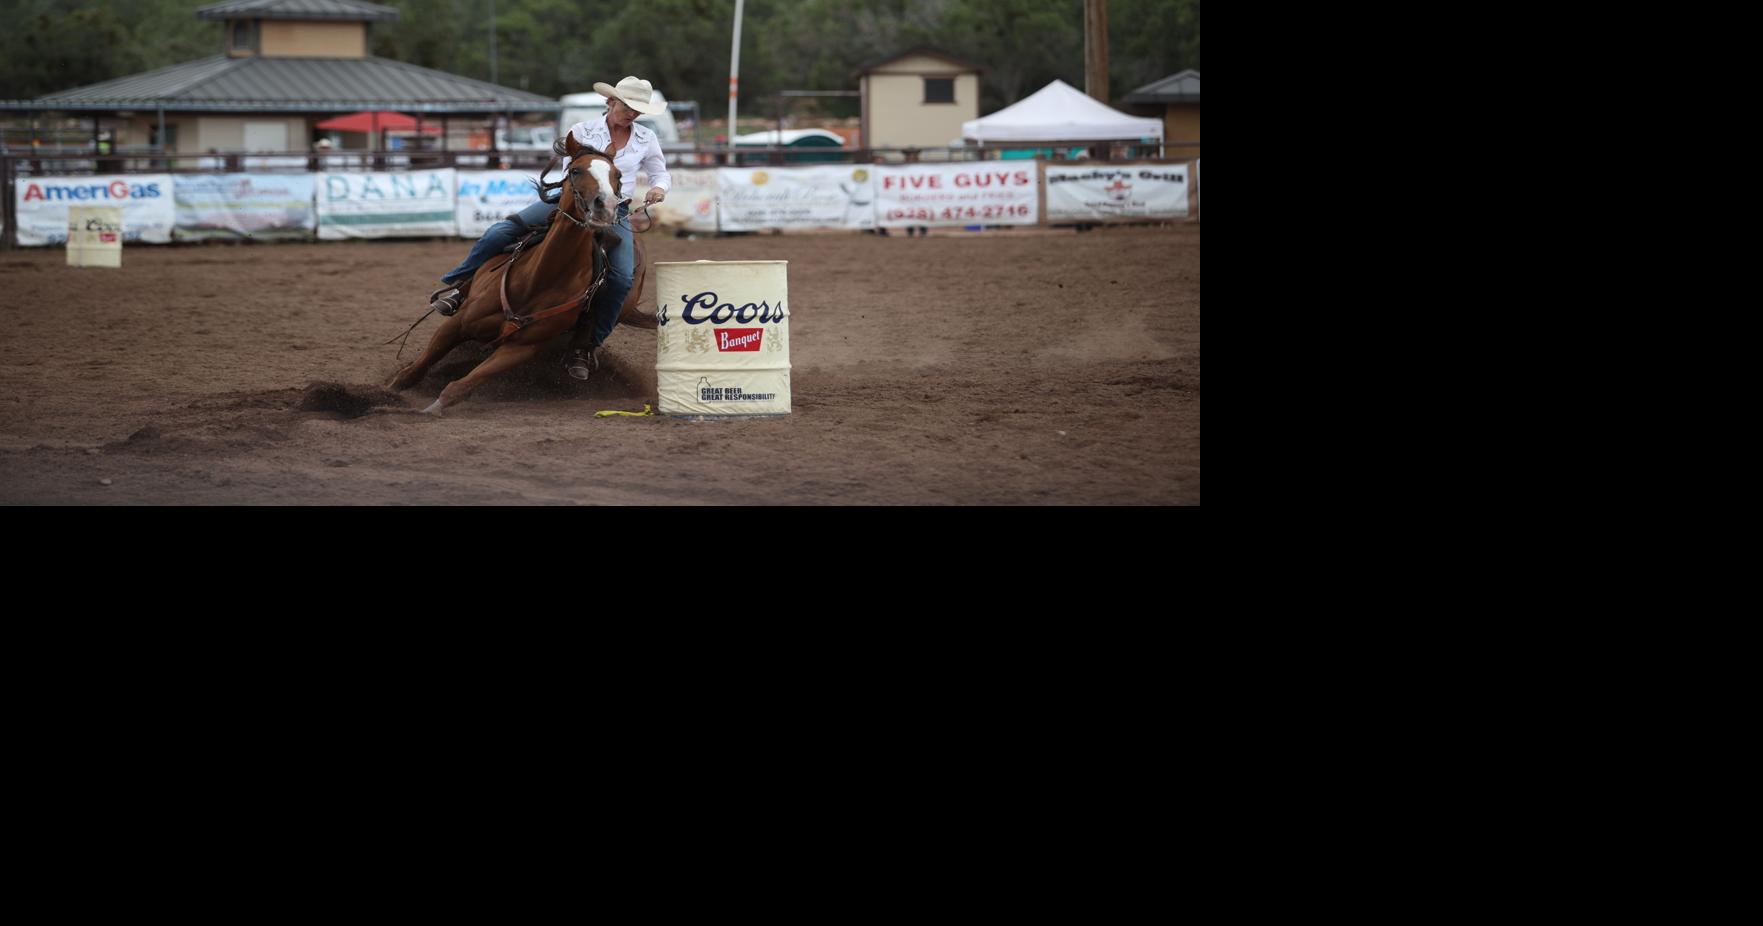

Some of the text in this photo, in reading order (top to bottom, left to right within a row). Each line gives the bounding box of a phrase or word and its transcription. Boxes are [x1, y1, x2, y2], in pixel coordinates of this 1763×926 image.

[23, 180, 160, 201] AmeriGas
[325, 173, 446, 201] DANA
[883, 171, 1030, 190] FIVE GUYS
[681, 291, 785, 325] Coors
[720, 330, 761, 350] Banquet
[724, 393, 776, 401] RESPONSIBILITY
